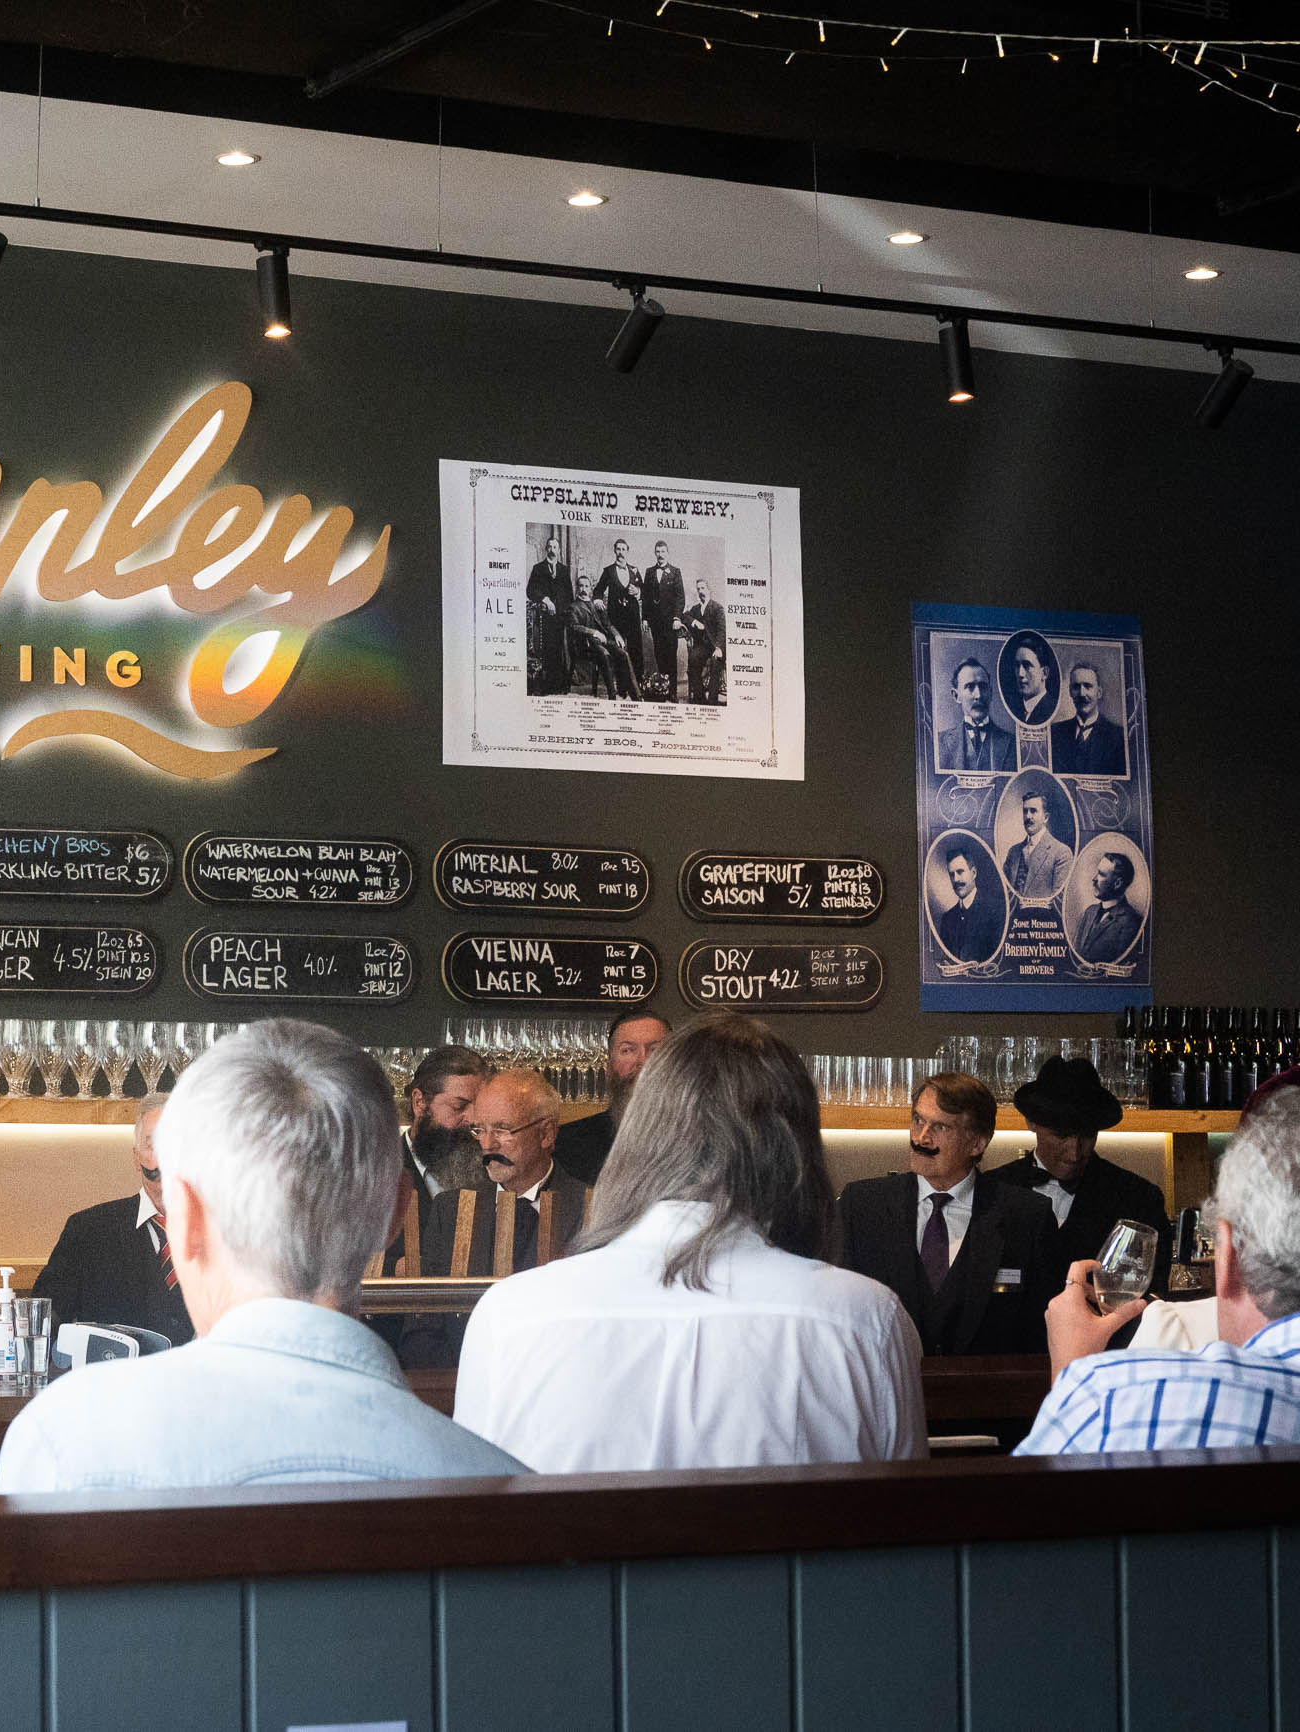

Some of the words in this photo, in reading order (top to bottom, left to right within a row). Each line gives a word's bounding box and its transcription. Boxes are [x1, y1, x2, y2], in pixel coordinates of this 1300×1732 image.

[510, 484, 618, 509] GIPPSLAND
[635, 494, 735, 520] BREWERY,
[560, 509, 592, 522] YORK
[601, 513, 648, 529] STREET,
[657, 518, 689, 531] SALE.
[488, 561, 510, 570] BRIGHT
[727, 577, 749, 587] BREWED
[750, 579, 767, 588] FROM
[485, 597, 514, 615] ALE
[727, 604, 767, 616] SPRING
[732, 665, 764, 674] GIPPSLAND
[528, 734, 595, 746] BREHENY
[124, 843, 150, 864] $6
[318, 845, 354, 861] BLAH
[387, 864, 397, 876] 7
[455, 851, 539, 875] IMPERIAL
[551, 852, 579, 871] 8.0%
[621, 858, 639, 874] 9.5
[64, 862, 132, 883] BITTER
[135, 866, 161, 886] 5%
[199, 863, 299, 884] WATERMELON
[699, 863, 805, 885] GRAPEFRUIT
[388, 877, 401, 890] 13
[452, 876, 537, 901] RASPBERRY
[541, 881, 581, 902] SOUR
[598, 883, 623, 895] PINT
[625, 883, 638, 898] 18
[824, 881, 851, 895] PINT
[251, 884, 299, 900] SOUR
[702, 886, 764, 905] SAISON
[787, 884, 812, 909] 5%
[821, 896, 851, 909] STEIN
[127, 933, 143, 949] 6.5
[210, 936, 282, 962] PEACH
[97, 950, 127, 964] PINT
[471, 939, 554, 965] VIENNA
[629, 945, 640, 960] 7
[845, 948, 859, 958] $7
[1005, 942, 1039, 957] BREHENY
[1038, 942, 1068, 957] FAMILY
[53, 944, 93, 972] 4.5%
[304, 953, 338, 976] 4.0%
[715, 949, 754, 972] DRY
[96, 966, 131, 981] STEIN
[135, 966, 152, 981] 20
[364, 963, 385, 977] PINT
[389, 961, 404, 977] 12
[603, 966, 626, 977] PINT
[631, 966, 646, 979] 13
[812, 962, 840, 973] PINT
[1019, 965, 1055, 975] BREWERS
[202, 963, 288, 990] LAGER
[476, 969, 542, 994] LAGER
[554, 966, 582, 986] 5.2%
[810, 976, 839, 987] STEIN
[358, 981, 386, 995] STEIN
[386, 982, 400, 996] 21
[600, 984, 629, 998] STEIN
[629, 984, 645, 997] 22
[701, 975, 767, 999] STOUT
